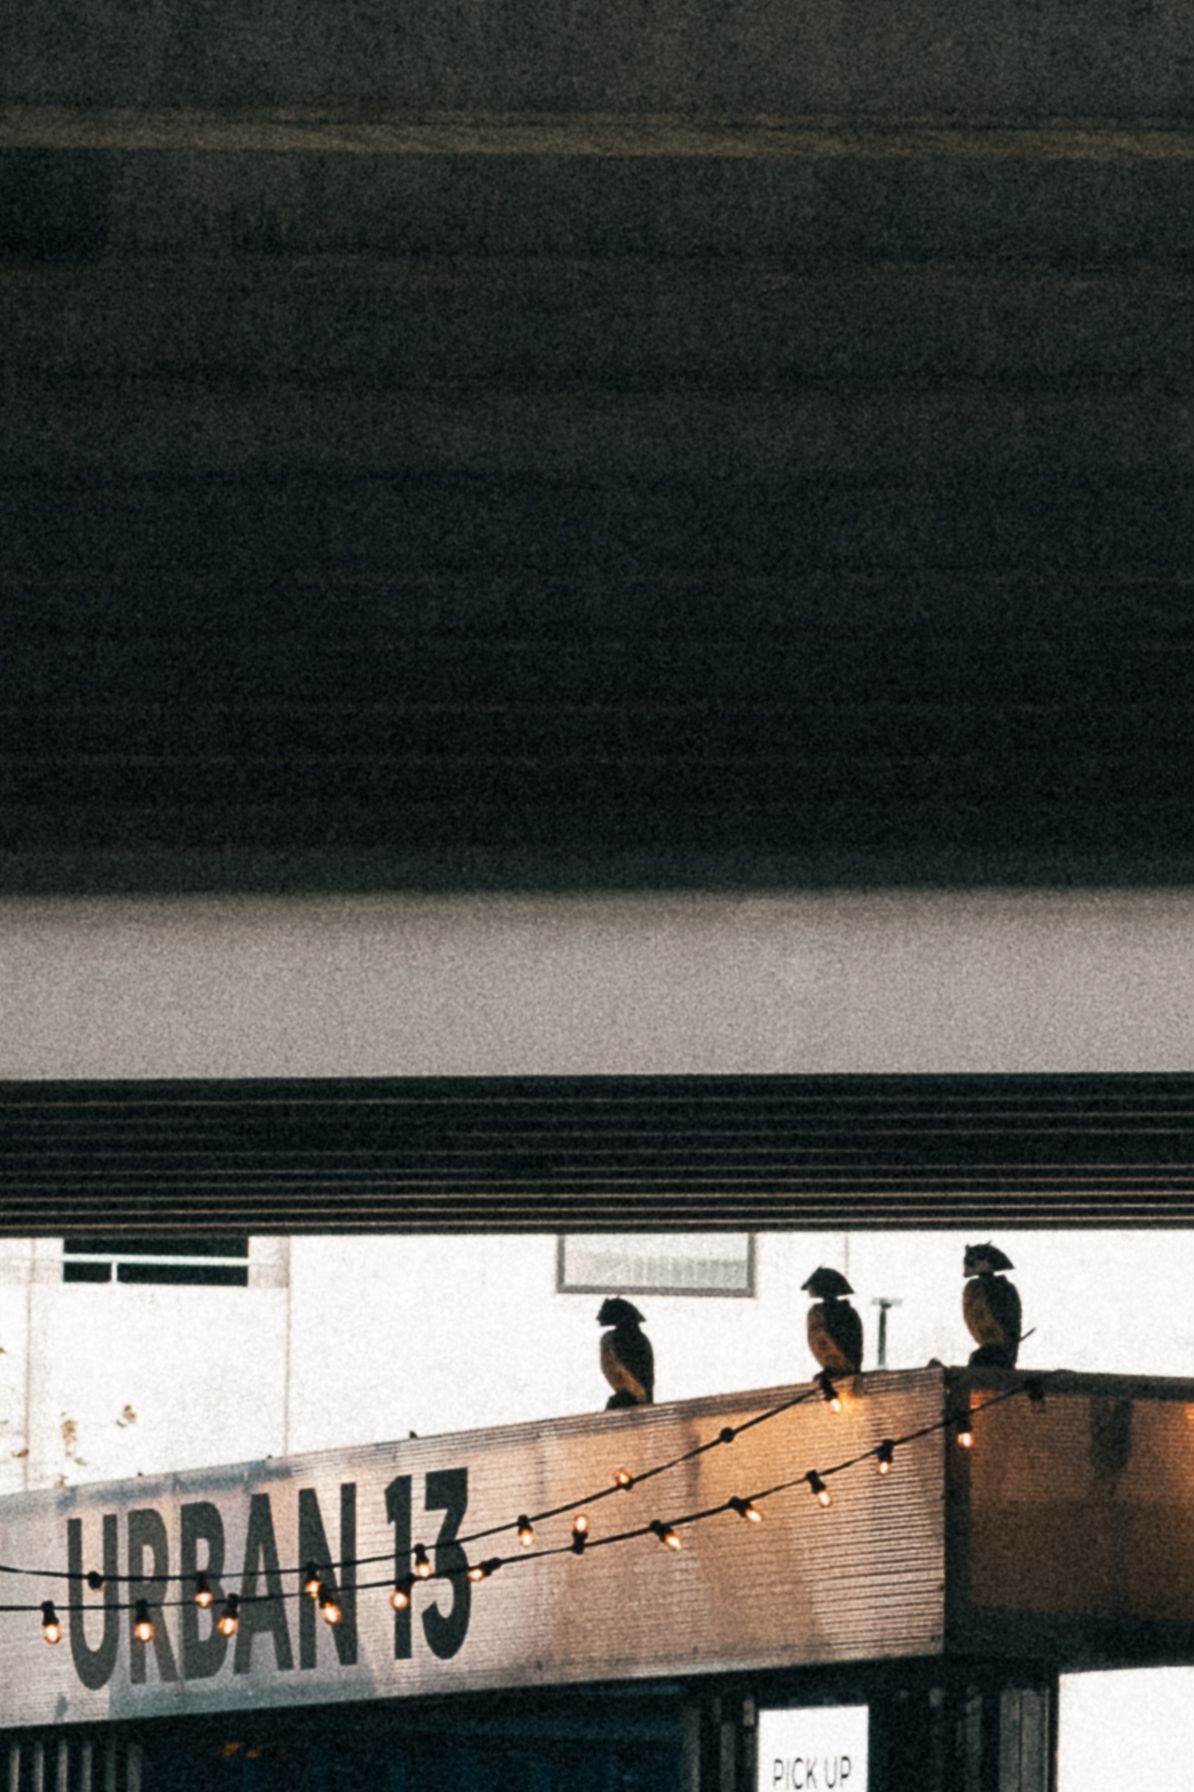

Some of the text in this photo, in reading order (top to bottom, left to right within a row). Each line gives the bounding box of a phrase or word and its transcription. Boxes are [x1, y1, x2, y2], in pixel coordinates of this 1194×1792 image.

[67, 1467, 473, 1690] URBAN 13
[772, 1755, 852, 1790] PICK UP
